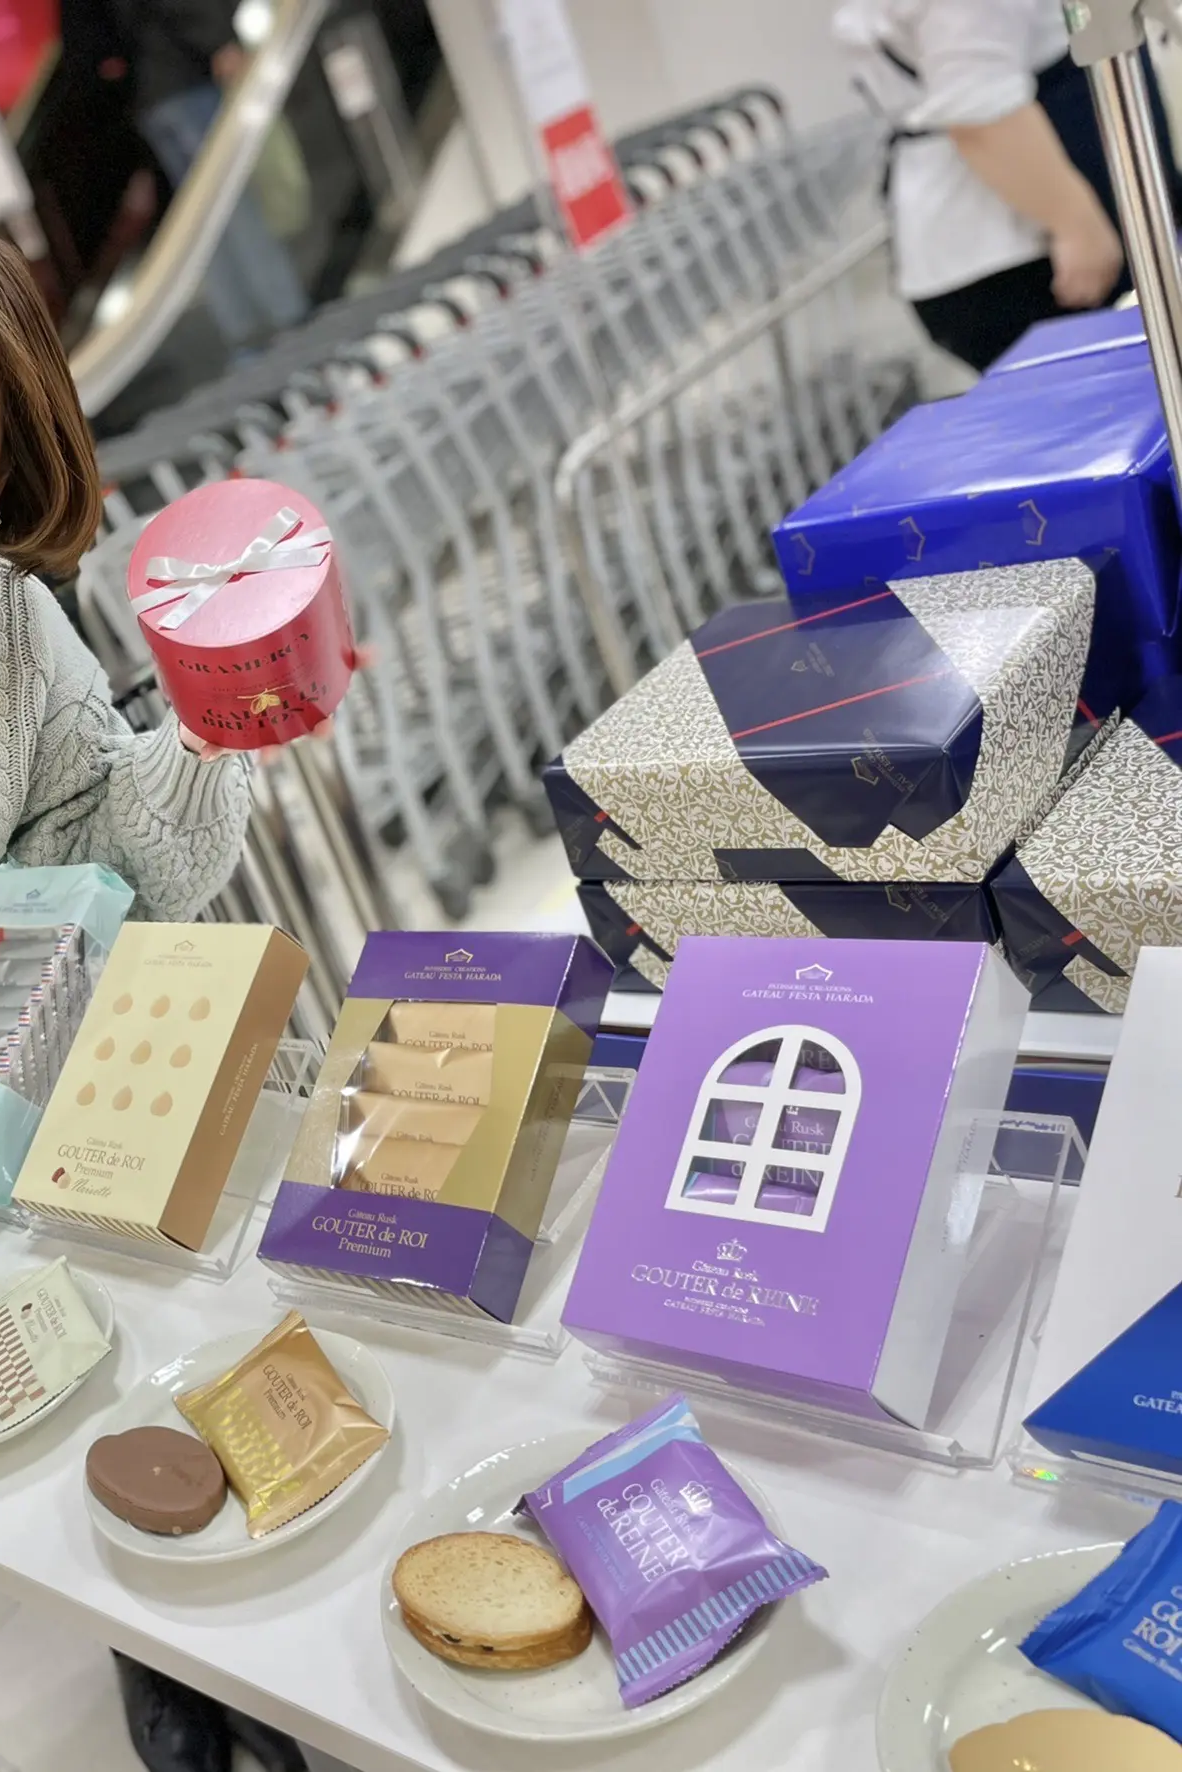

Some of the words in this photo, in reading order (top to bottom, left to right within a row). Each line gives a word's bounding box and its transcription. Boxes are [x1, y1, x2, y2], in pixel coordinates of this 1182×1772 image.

[404, 971, 436, 980] GATEAU
[438, 972, 463, 981] FESTA
[465, 973, 502, 982] HARADA
[742, 989, 785, 999] GATEAU
[788, 991, 821, 1001] FESTA
[825, 992, 875, 1004] HARADA
[791, 1120, 826, 1137] Rusk
[57, 1144, 107, 1165] GOUTER
[106, 1152, 120, 1166] de
[121, 1154, 146, 1171] ROI
[74, 1162, 114, 1180] Premium
[762, 1166, 820, 1187] REIN
[70, 1177, 112, 1198] Noisette
[407, 1186, 422, 1200] de
[423, 1188, 439, 1202] RO
[377, 1212, 397, 1225] Rusk
[312, 1215, 377, 1240] GOUTER
[378, 1226, 396, 1243] de
[398, 1228, 429, 1249] ROI
[338, 1237, 392, 1258] Premium
[732, 1266, 759, 1283] Rusk
[631, 1264, 719, 1297] GOUTER
[721, 1282, 745, 1301] de
[746, 1284, 822, 1316] REINE
[37, 1288, 58, 1320] GOUTER
[663, 1298, 697, 1313] GATEAU
[699, 1306, 725, 1319] FESTA
[727, 1311, 767, 1328] HARADA
[263, 1364, 293, 1403] GOUTER
[287, 1399, 298, 1413] de
[293, 1408, 312, 1430] ROI
[263, 1388, 286, 1420] Premium
[622, 1483, 690, 1568] GOUTER
[1131, 1616, 1182, 1656] ROI
